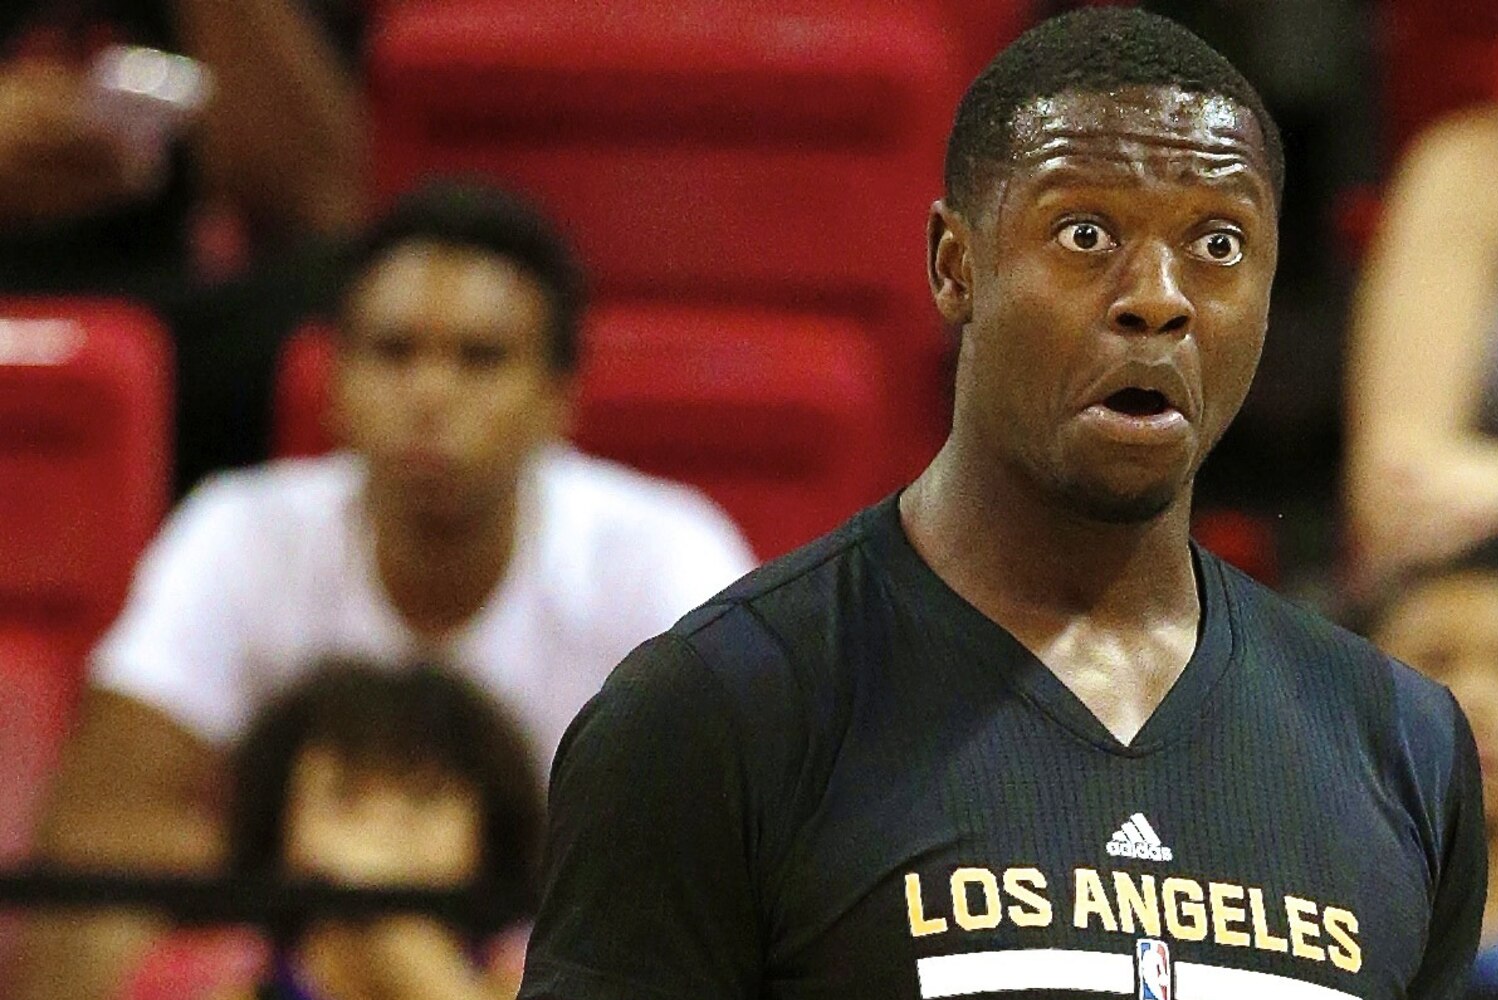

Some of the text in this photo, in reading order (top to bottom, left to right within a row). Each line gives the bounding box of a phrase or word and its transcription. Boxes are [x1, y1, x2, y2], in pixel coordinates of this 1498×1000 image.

[1105, 841, 1173, 862] adidas
[905, 867, 1362, 973] LOS ANGELES
